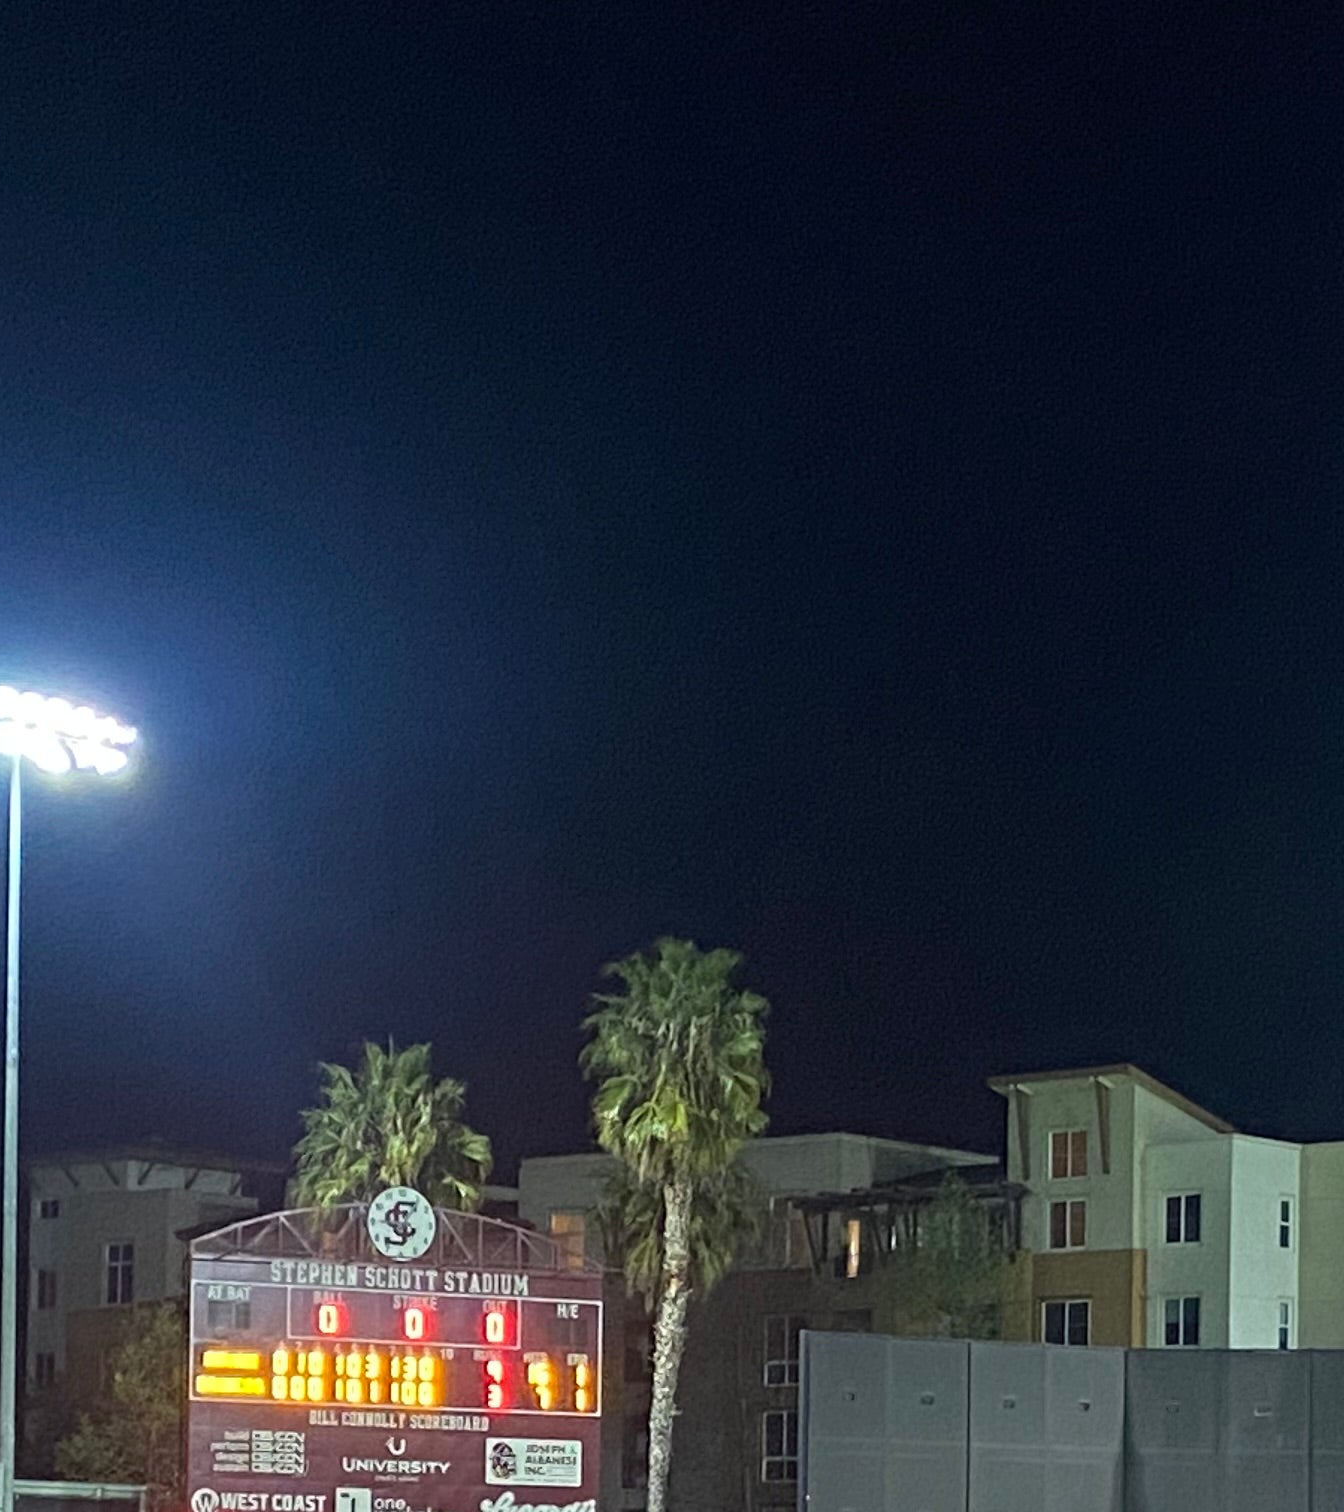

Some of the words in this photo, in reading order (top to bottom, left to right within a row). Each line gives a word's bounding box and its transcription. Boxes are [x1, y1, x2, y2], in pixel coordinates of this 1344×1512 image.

[270, 1261, 357, 1284] STEPHEN
[365, 1267, 437, 1291] SCHOTT
[444, 1272, 529, 1296] STADIUM
[208, 1286, 223, 1299] AT
[227, 1286, 250, 1300] BAT
[557, 1304, 579, 1319] H/E
[319, 1305, 337, 1333] 0
[405, 1309, 423, 1339] 0
[486, 1312, 504, 1342] 0
[440, 1348, 454, 1360] 10
[309, 1410, 338, 1425] BILL
[410, 1415, 489, 1431] SCOREBOARD
[343, 1457, 451, 1475] UNIVERSITY
[221, 1492, 269, 1510] WEST
[272, 1494, 327, 1512] COAST
[374, 1498, 406, 1510] one
